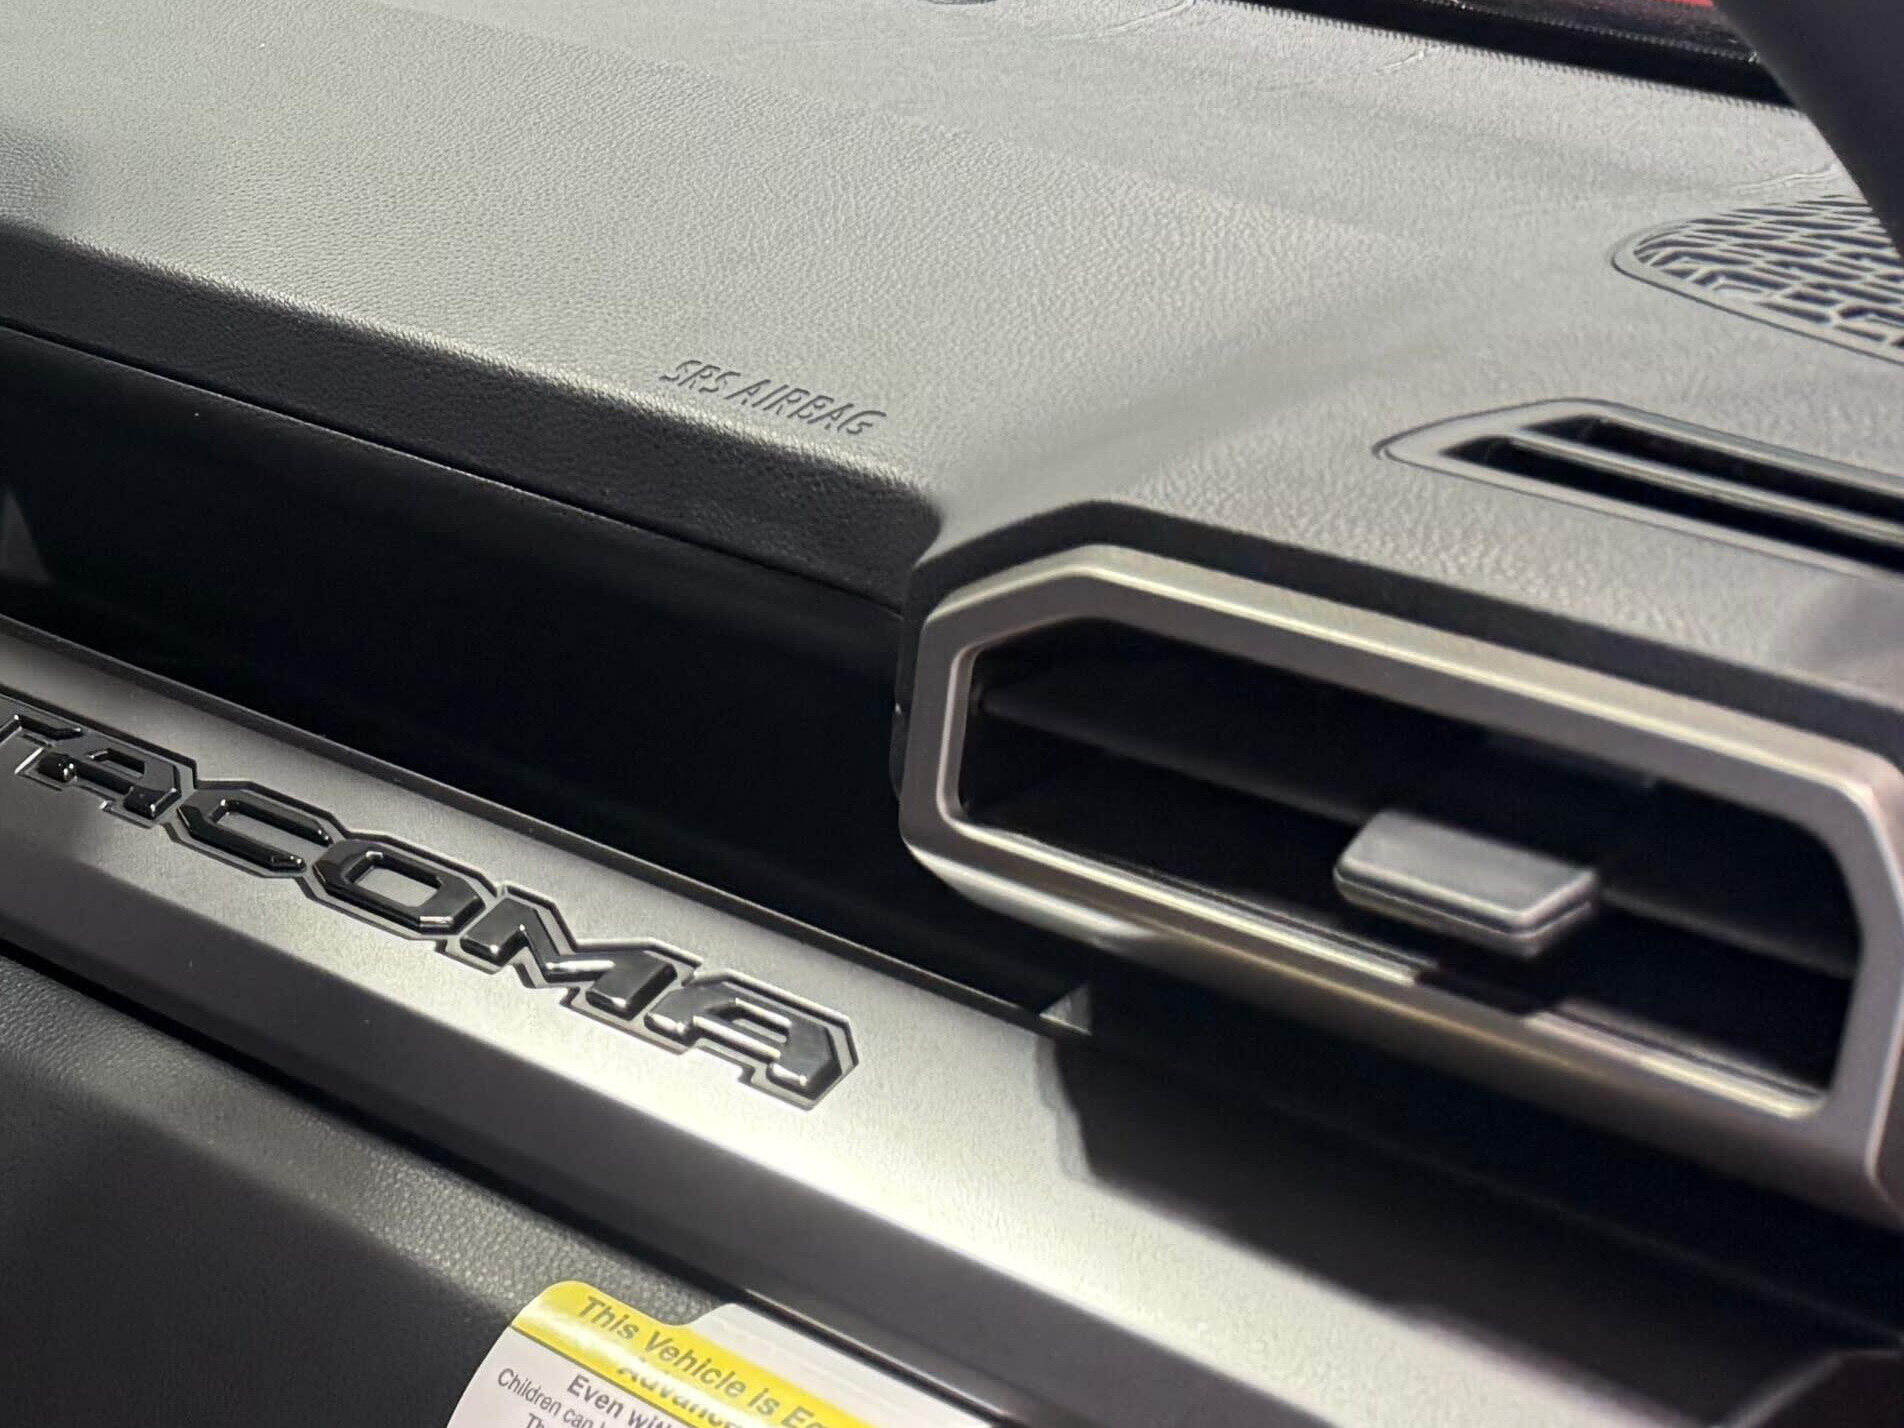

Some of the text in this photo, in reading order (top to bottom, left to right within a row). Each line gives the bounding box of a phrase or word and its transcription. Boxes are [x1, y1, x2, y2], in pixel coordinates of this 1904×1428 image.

[659, 359, 888, 438] SRS AIRBAG
[577, 1294, 640, 1339] This
[643, 1329, 746, 1397] Vehicle
[746, 1386, 780, 1416] is
[496, 1367, 562, 1416] Children
[566, 1373, 624, 1419] Even
